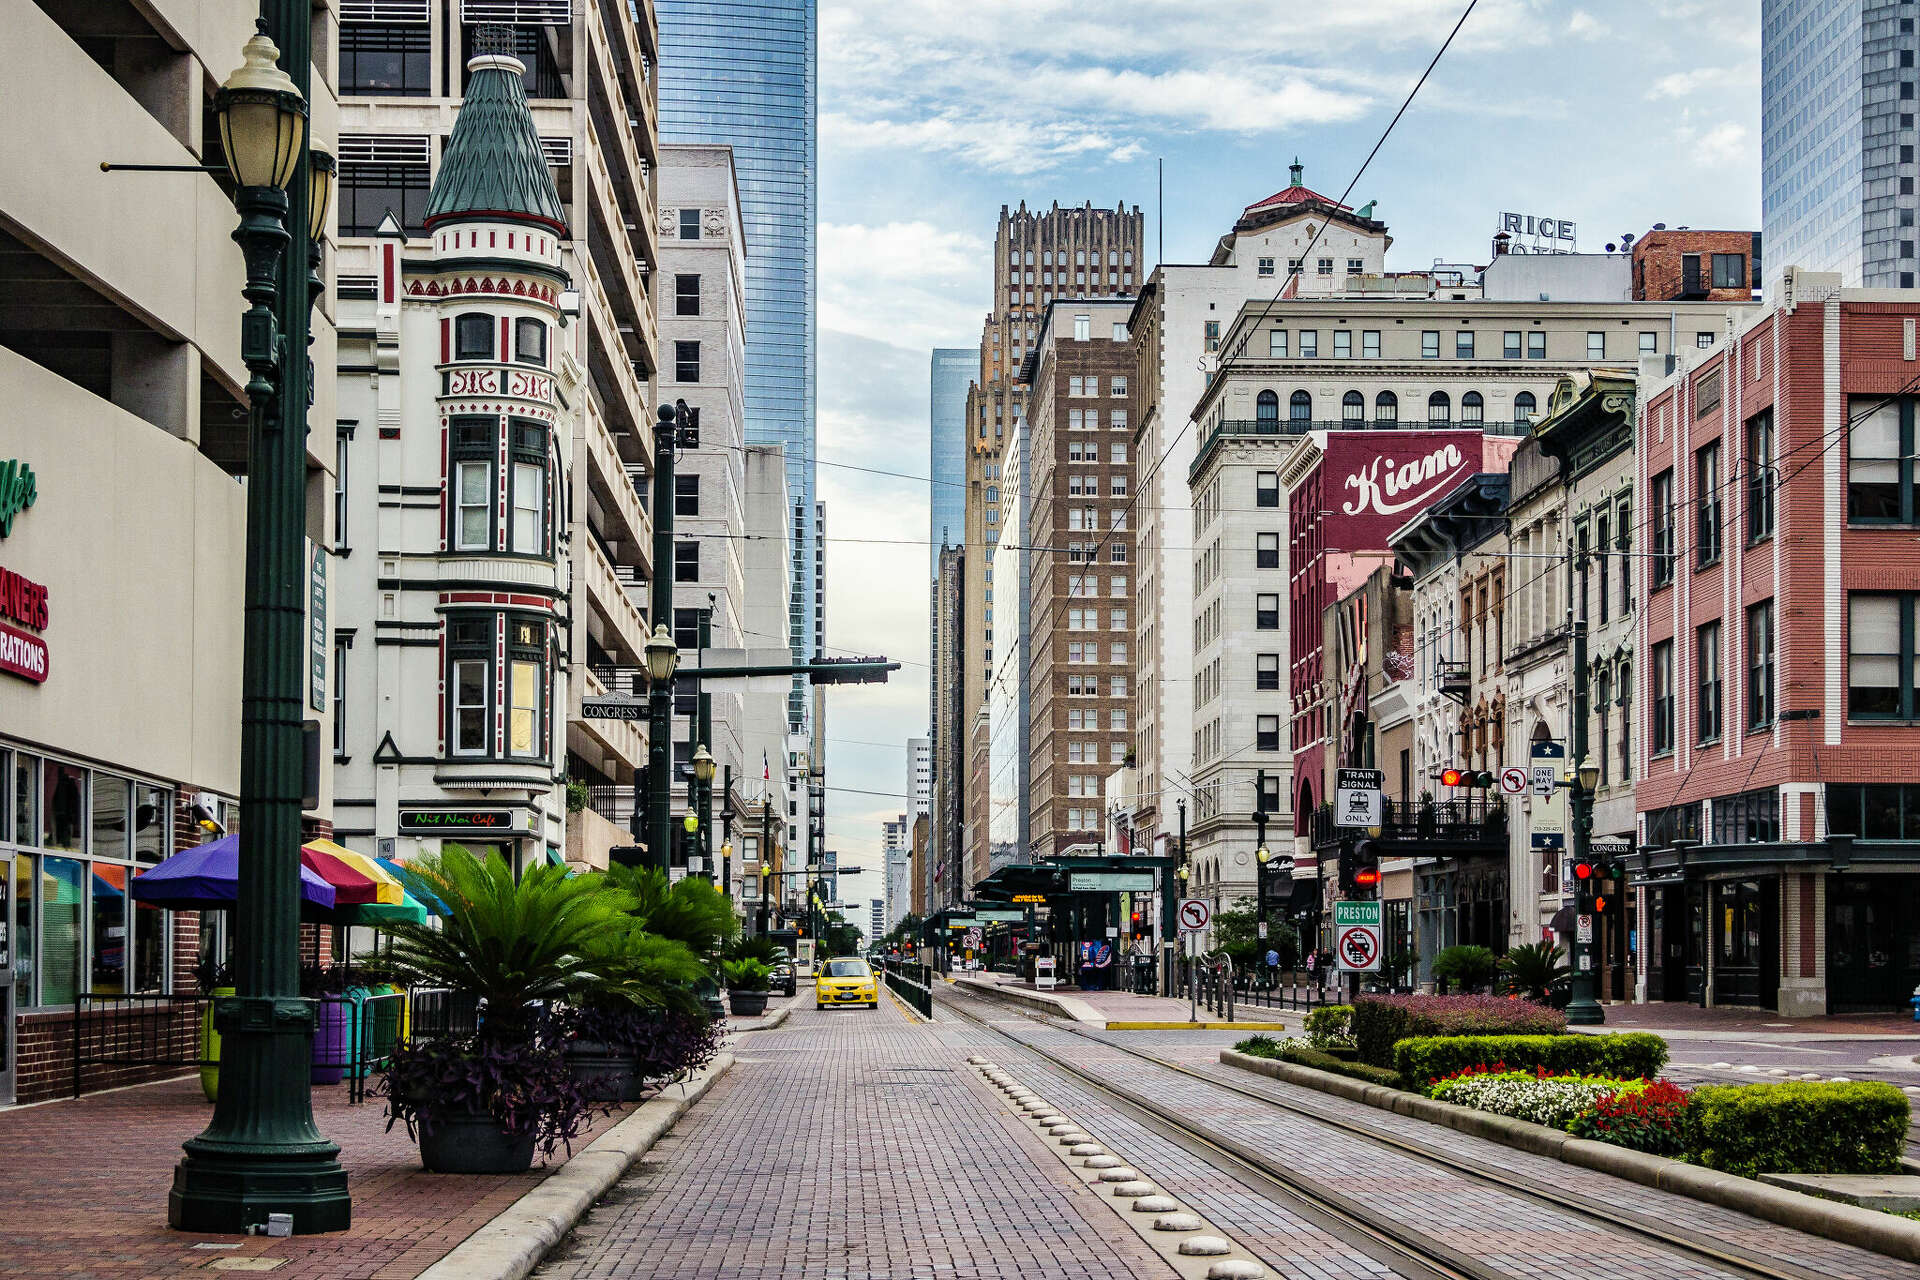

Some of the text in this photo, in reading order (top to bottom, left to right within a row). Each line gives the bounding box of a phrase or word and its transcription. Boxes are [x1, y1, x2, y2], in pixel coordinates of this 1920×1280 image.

[1504, 213, 1574, 240] RICE
[1342, 443, 1467, 516] Kiam
[0, 630, 45, 675] RATIONS
[583, 705, 638, 719] CONGRESS
[1345, 771, 1375, 779] TRAIN
[1535, 769, 1552, 777] ONE
[1341, 780, 1378, 789] SIGNAL
[415, 814, 440, 824] Nit
[1345, 814, 1372, 823] ONLY
[1592, 844, 1629, 853] CONGRESS
[1338, 906, 1378, 920] PRESTON
